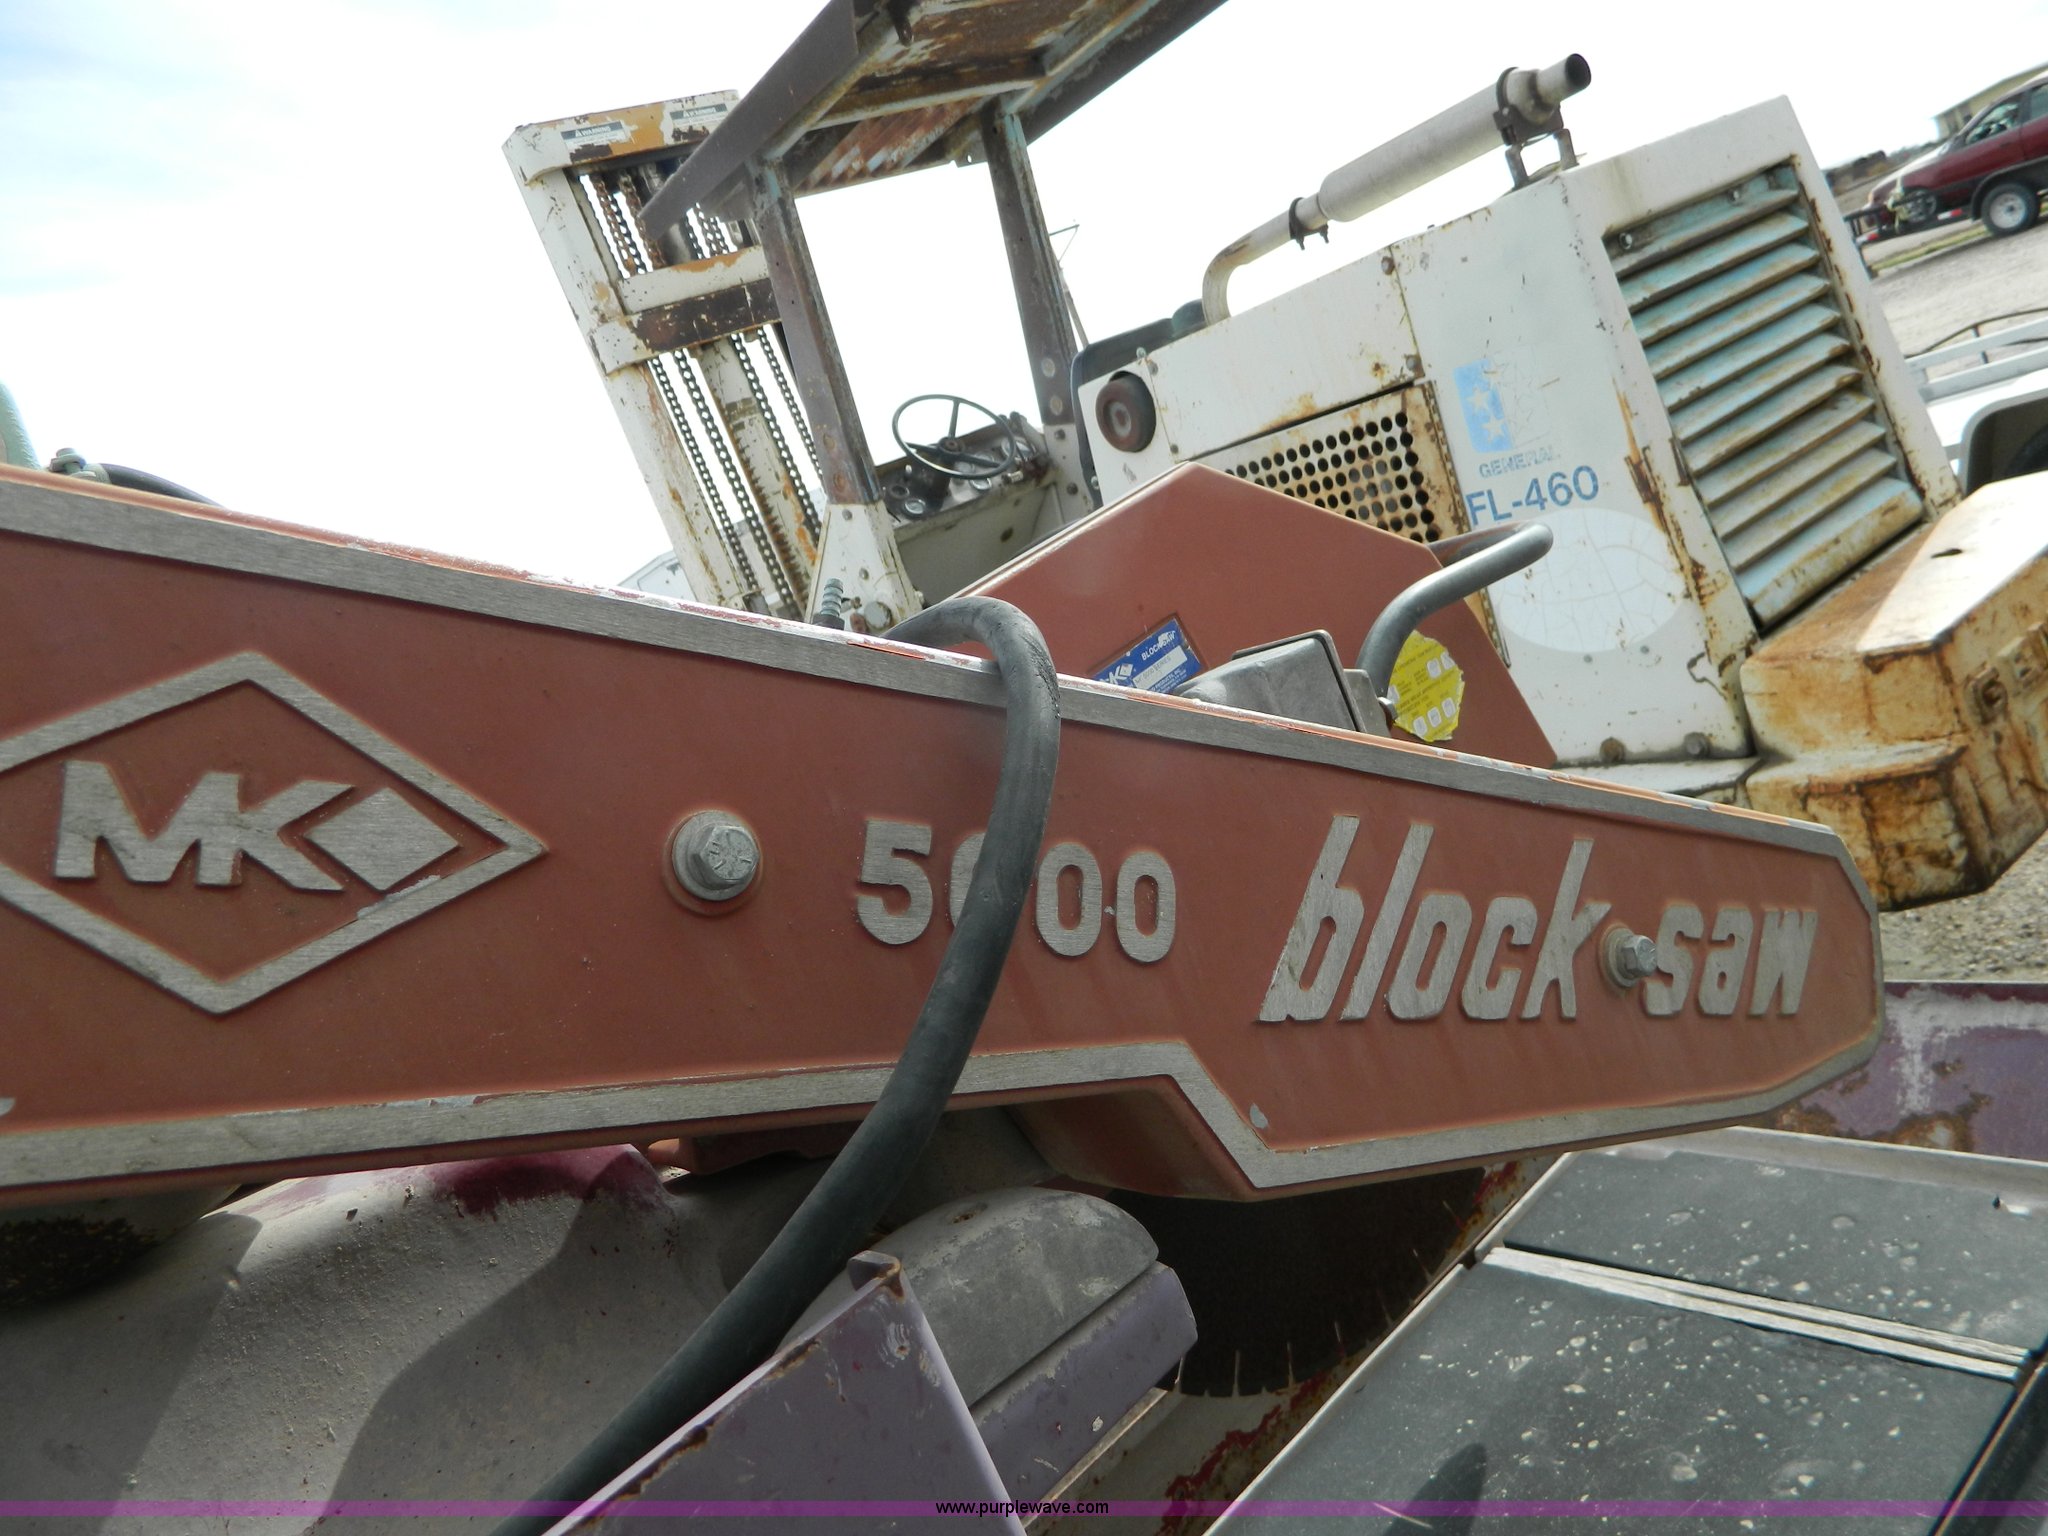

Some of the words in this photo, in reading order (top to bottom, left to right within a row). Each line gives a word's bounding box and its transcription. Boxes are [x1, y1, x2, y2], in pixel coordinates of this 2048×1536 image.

[1465, 464, 1600, 527] FL-460
[54, 759, 355, 893] MK
[1258, 814, 1612, 1023] block
[1641, 903, 1819, 1016] saw
